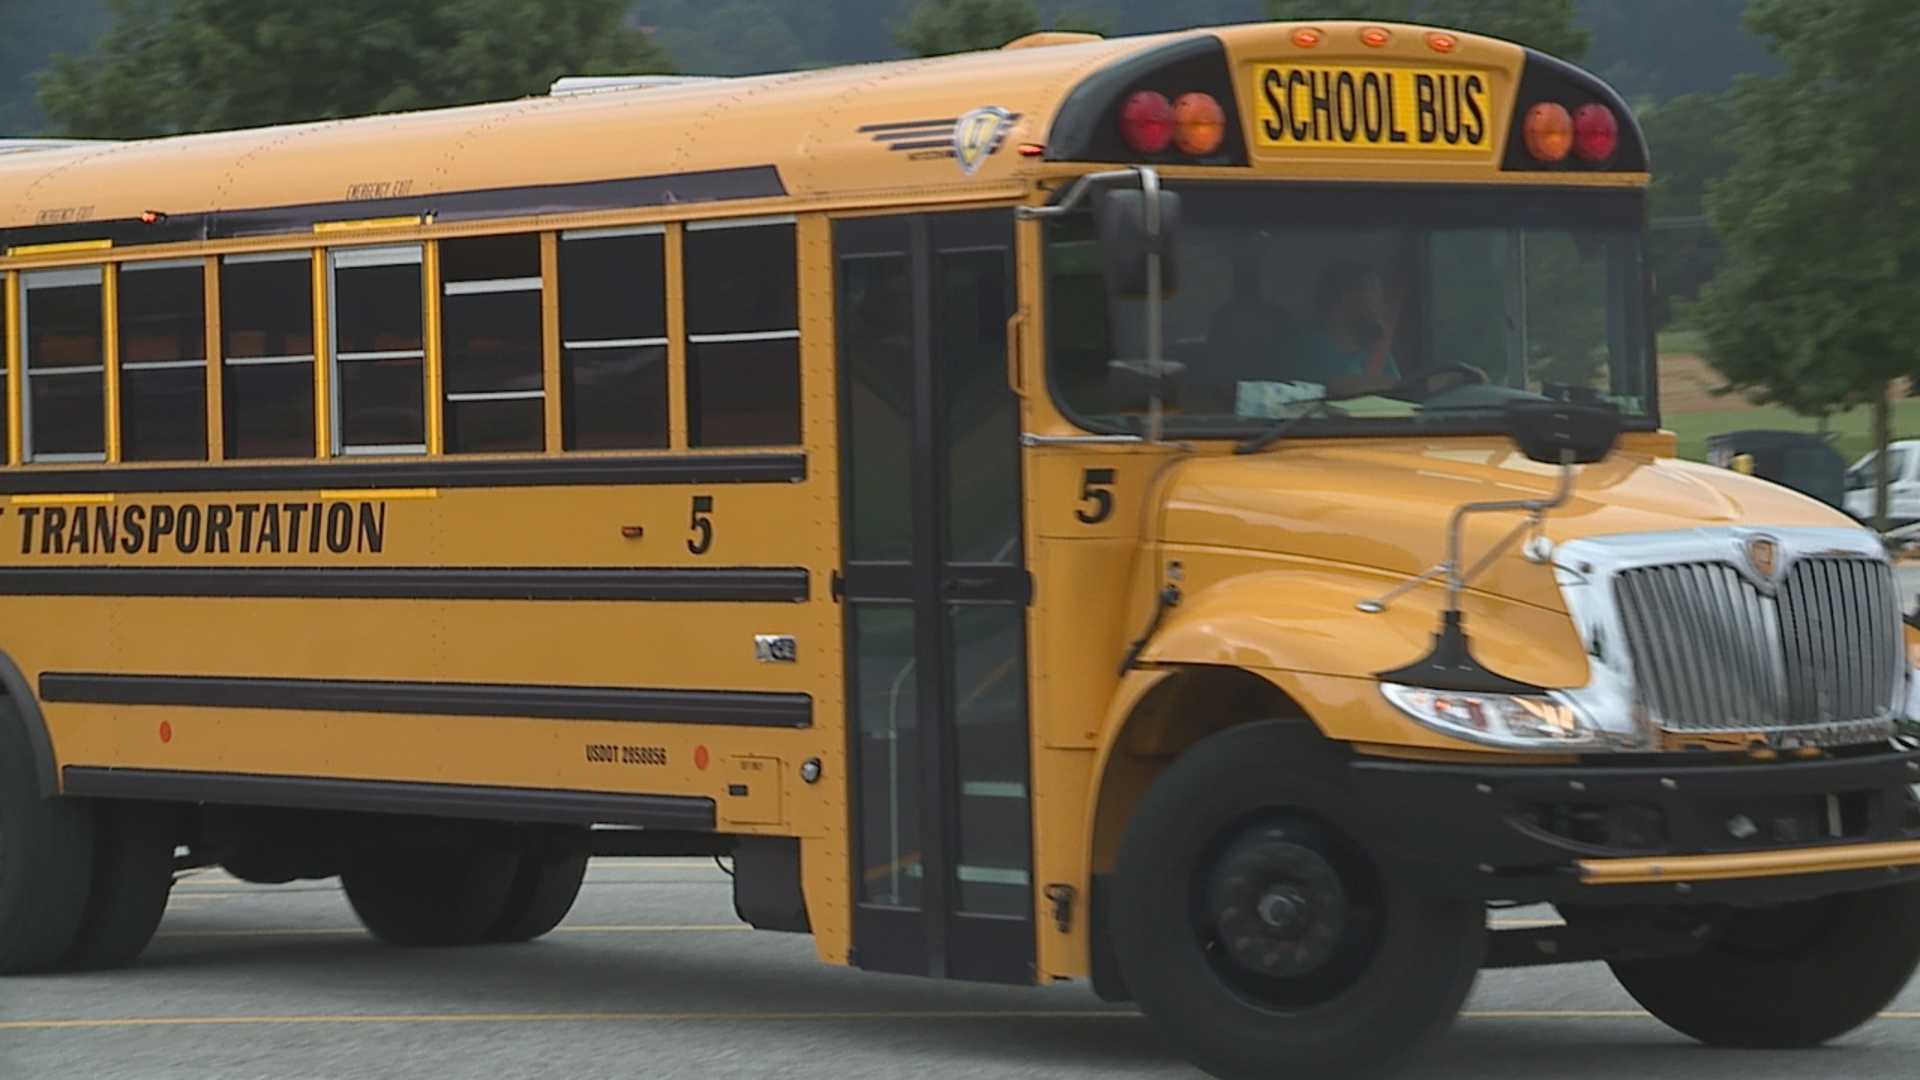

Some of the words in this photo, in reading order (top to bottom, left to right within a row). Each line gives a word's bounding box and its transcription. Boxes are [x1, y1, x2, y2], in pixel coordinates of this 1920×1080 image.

[1263, 68, 1407, 143] SCHOOL
[1414, 73, 1484, 145] BUS
[1073, 468, 1117, 524] 5
[18, 502, 385, 554] TRANSPORTATION
[687, 495, 713, 555] 5
[586, 743, 619, 763] USDOT
